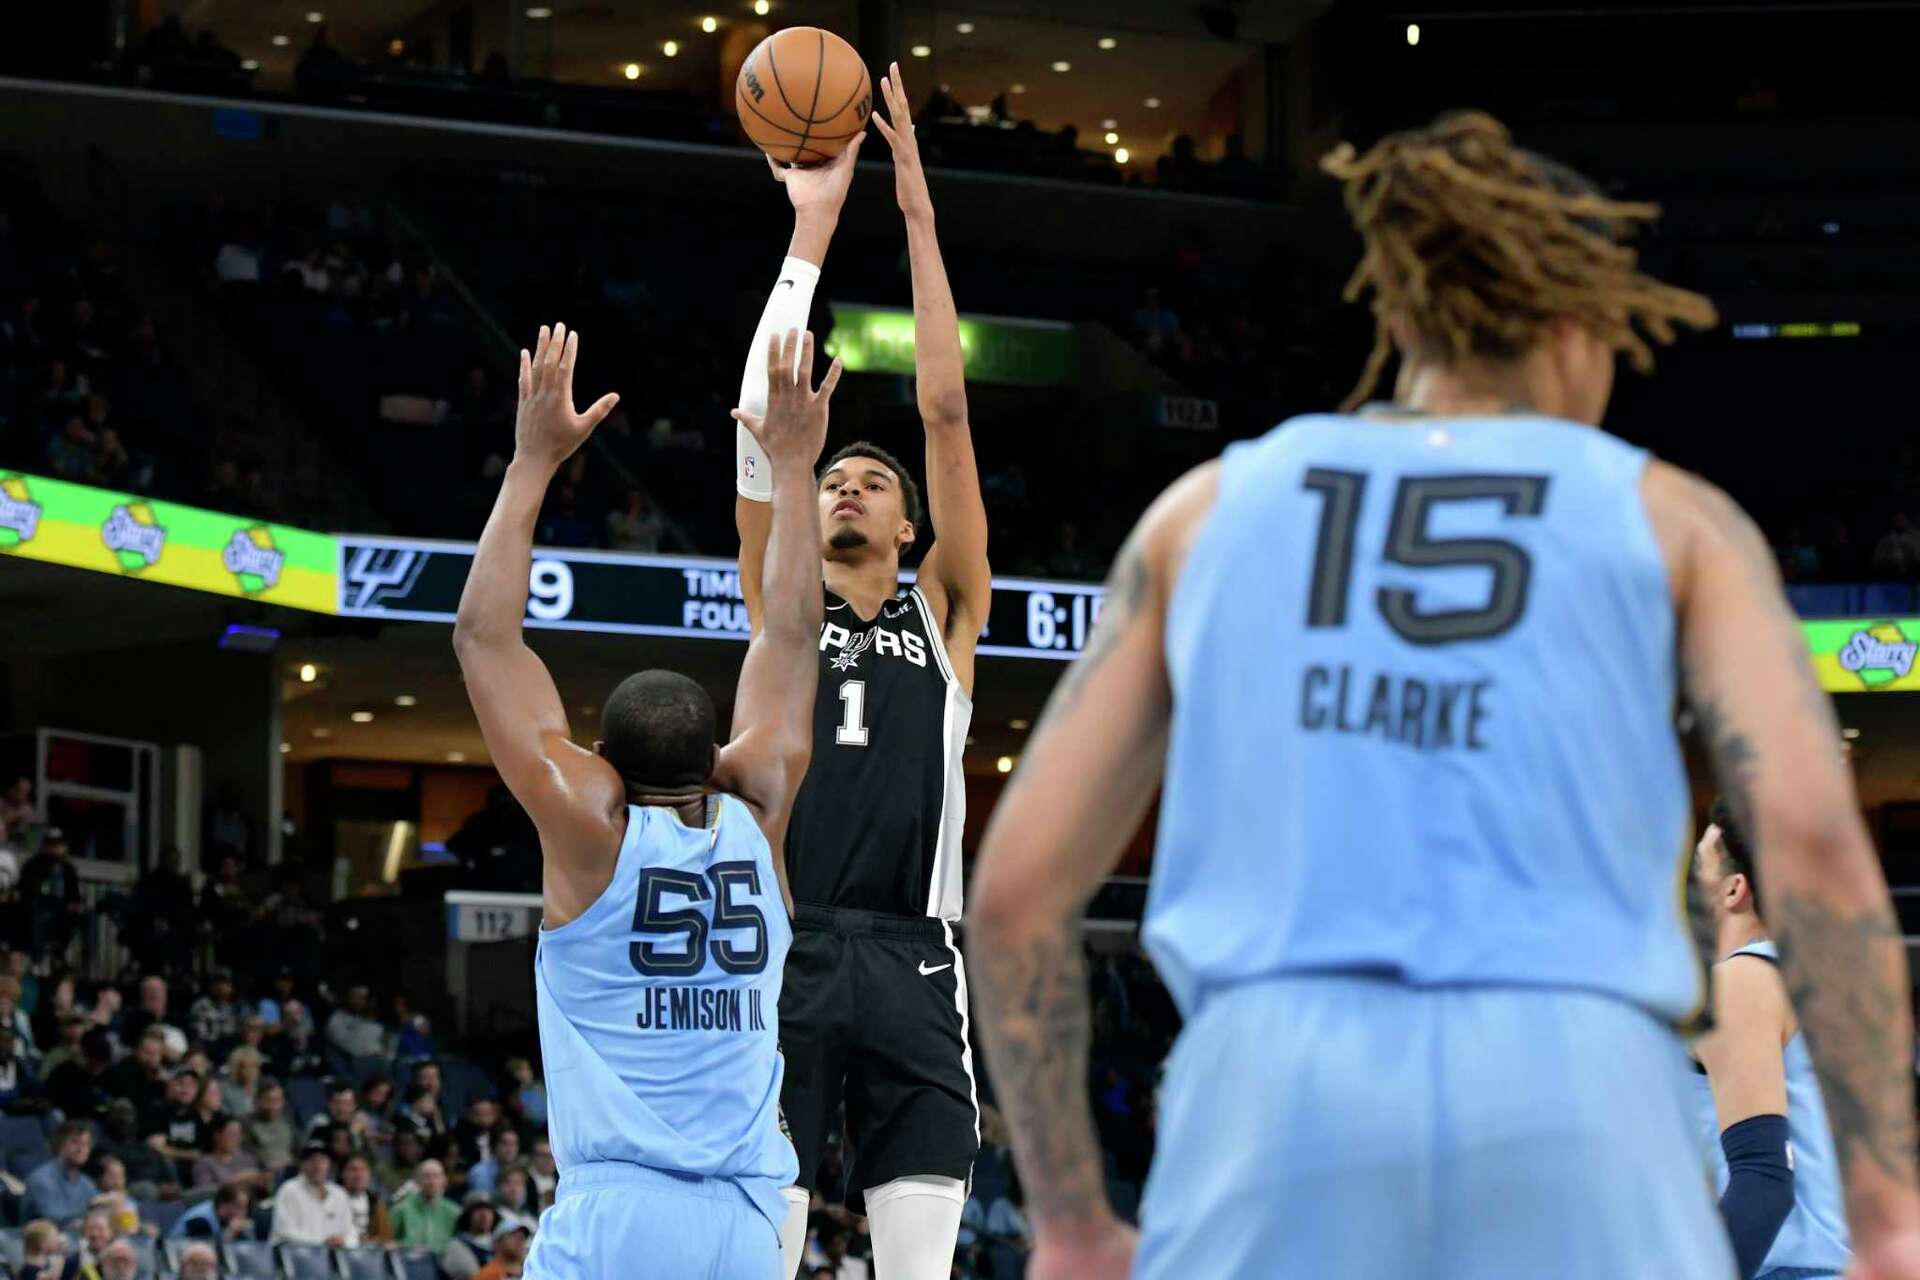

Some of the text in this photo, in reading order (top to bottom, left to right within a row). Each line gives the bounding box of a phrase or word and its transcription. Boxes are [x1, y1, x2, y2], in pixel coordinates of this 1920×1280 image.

[1302, 467, 1549, 646] 15
[527, 559, 574, 620] 9
[819, 621, 927, 672] PURS
[1027, 591, 1102, 650] 6:1
[1840, 630, 1917, 677] Starry
[836, 679, 869, 746] 1
[1301, 665, 1494, 753] CLARKE
[476, 910, 514, 937] 112
[629, 860, 769, 977] 55
[636, 986, 767, 1032] JEMISON III
